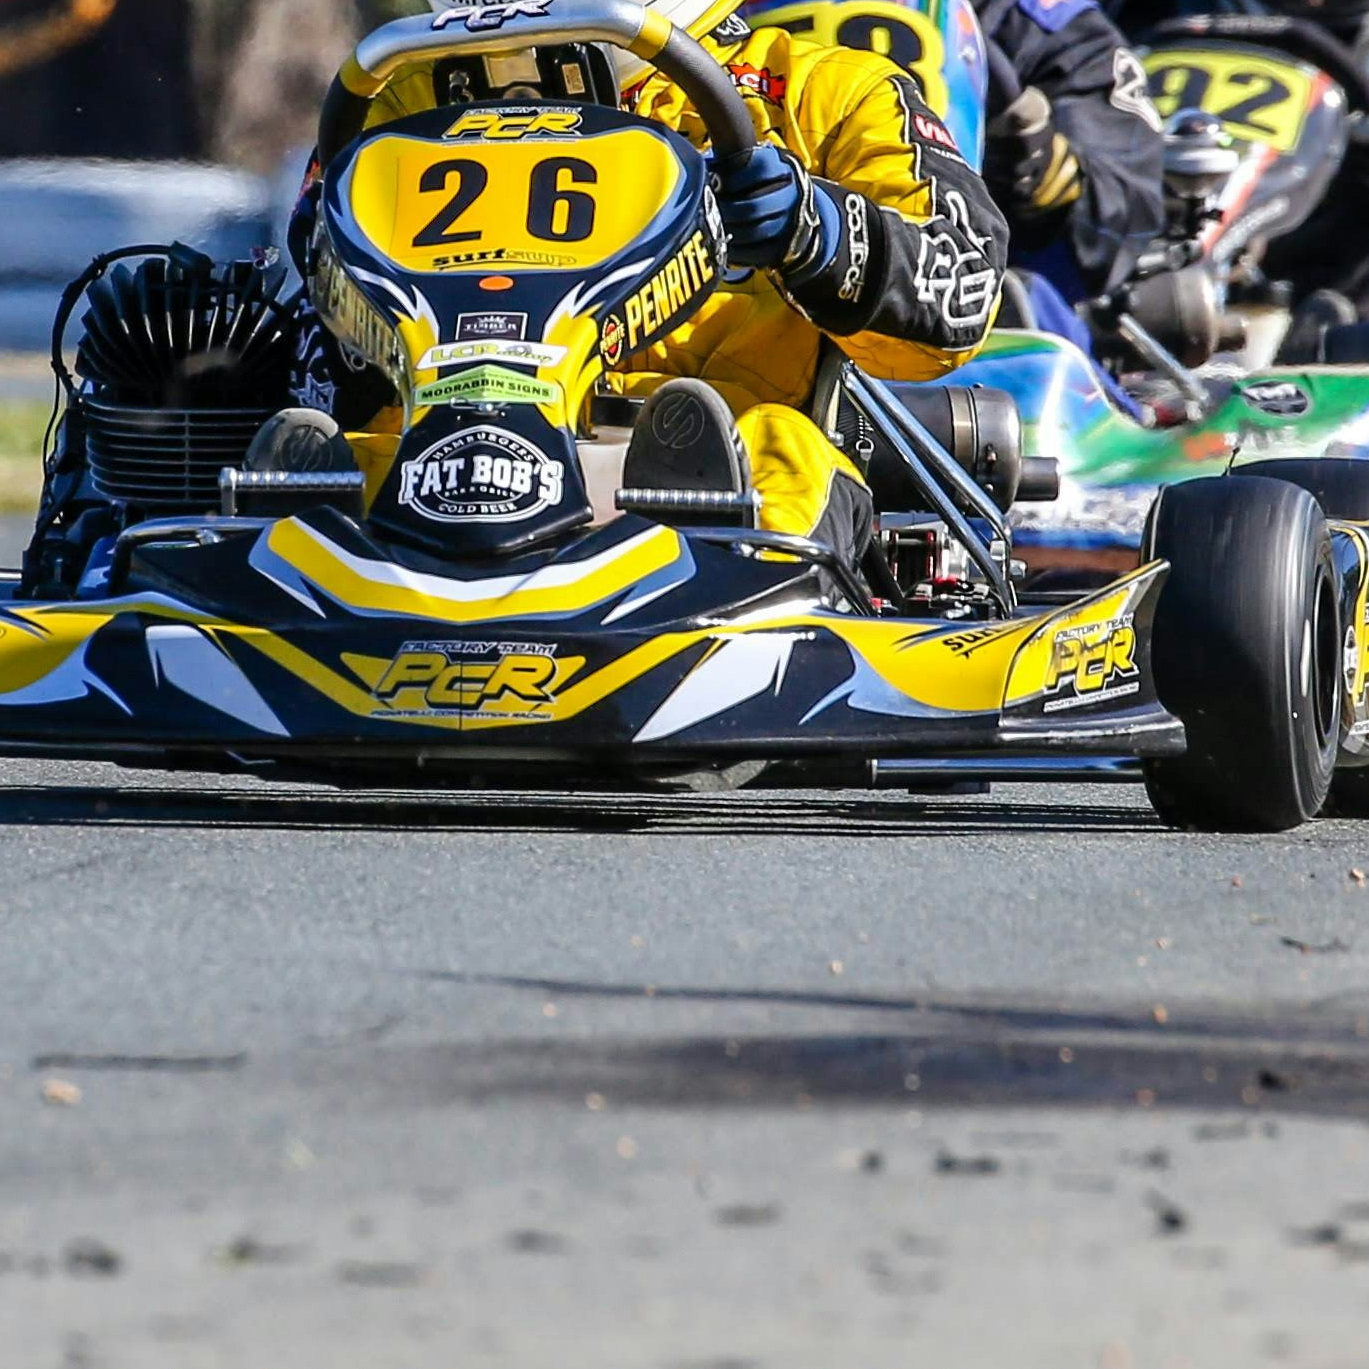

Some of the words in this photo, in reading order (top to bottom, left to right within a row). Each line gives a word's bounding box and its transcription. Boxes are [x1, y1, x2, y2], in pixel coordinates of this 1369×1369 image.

[1146, 62, 1292, 136] 92
[442, 112, 584, 140] PCR
[411, 157, 598, 248] 26
[433, 247, 578, 268] surfsup
[625, 229, 714, 349] PENRITE
[422, 379, 504, 399] MOORABBIN
[507, 382, 551, 397] SIGNS
[432, 432, 536, 462] HAMBURGERS
[403, 458, 465, 501] FAT
[471, 454, 562, 504] BOB'S
[479, 485, 517, 499] GRILL
[438, 502, 477, 515] COLD
[480, 502, 518, 515] BEER
[401, 640, 497, 654] FACTORY
[498, 642, 558, 656] TEAM
[1043, 625, 1140, 696] PCR
[372, 651, 557, 711] PCR
